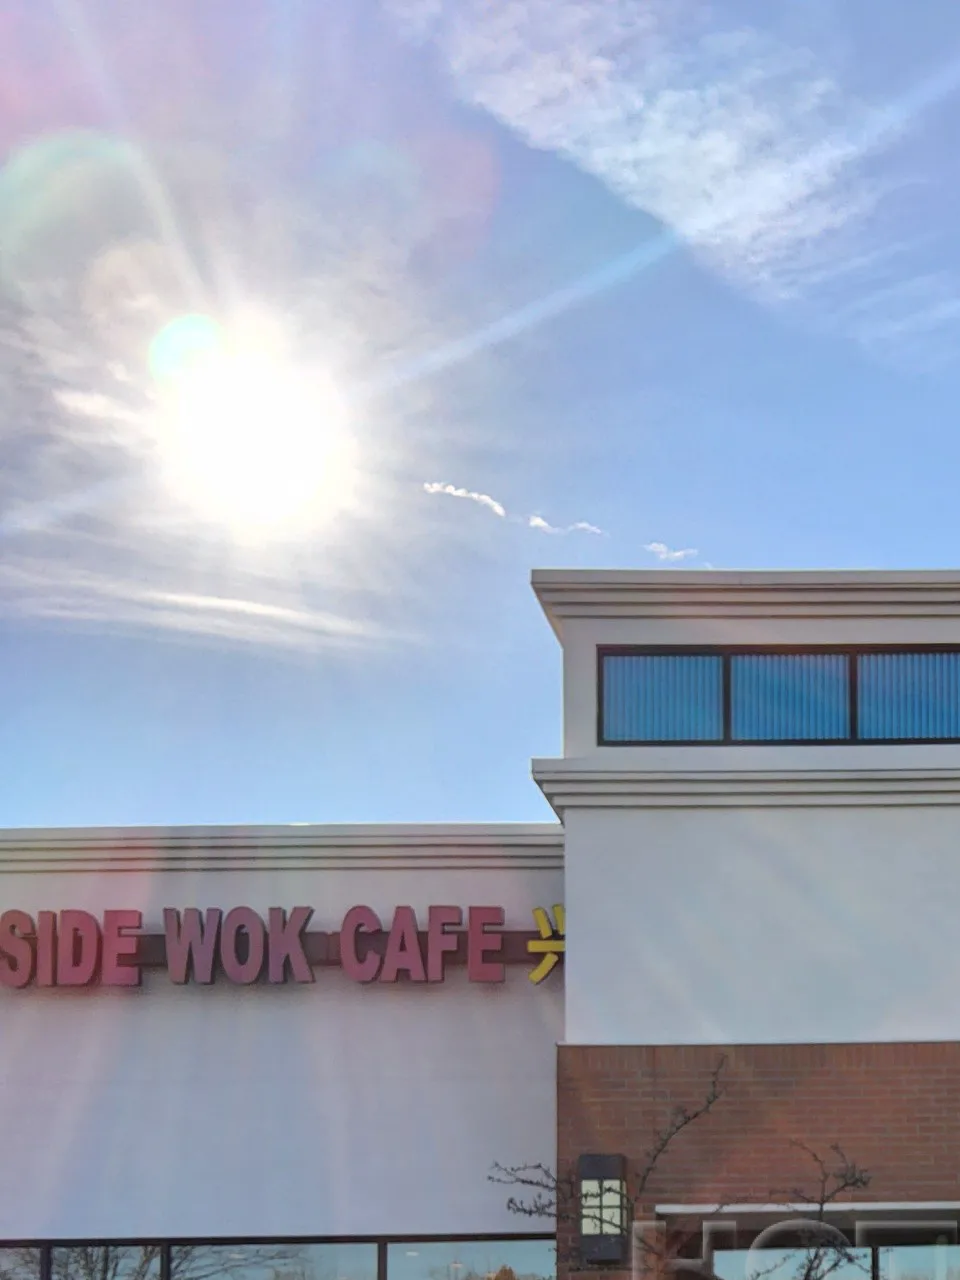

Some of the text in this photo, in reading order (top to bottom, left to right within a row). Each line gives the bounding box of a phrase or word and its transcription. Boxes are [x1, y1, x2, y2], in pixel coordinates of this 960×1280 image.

[0, 909, 142, 988] SIDE
[163, 906, 314, 985] WOK
[340, 905, 506, 984] CAFE
